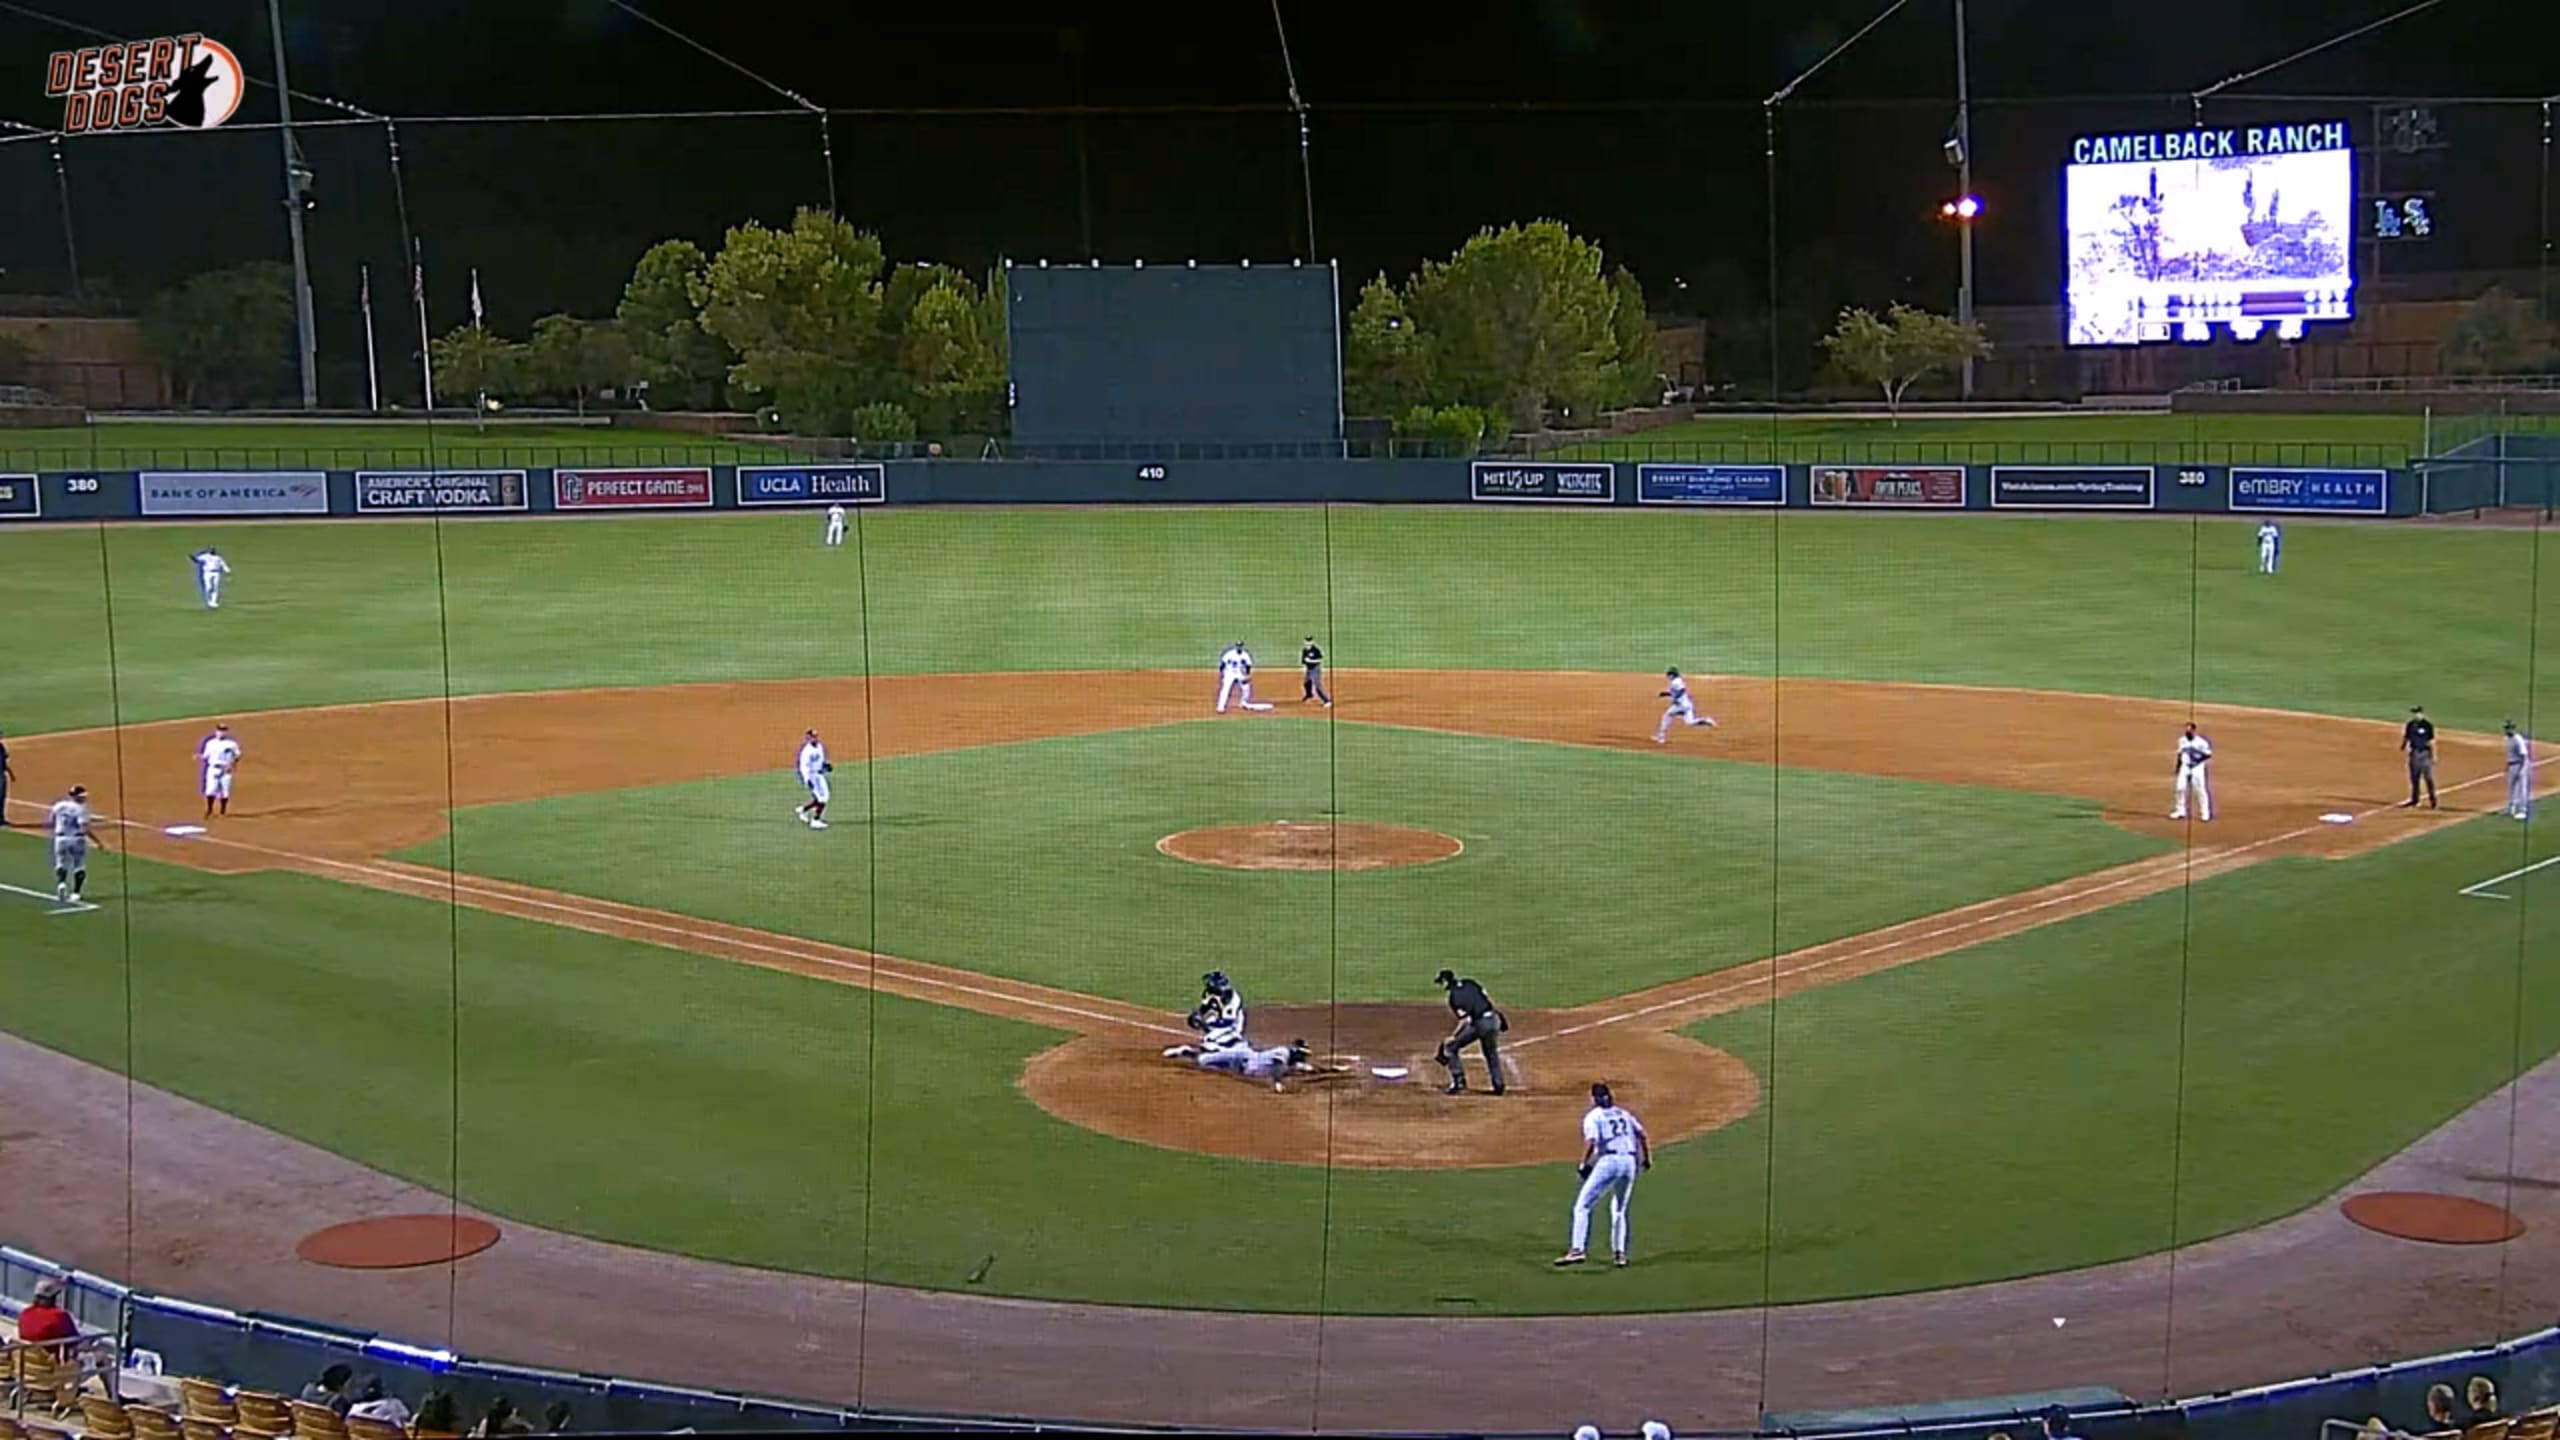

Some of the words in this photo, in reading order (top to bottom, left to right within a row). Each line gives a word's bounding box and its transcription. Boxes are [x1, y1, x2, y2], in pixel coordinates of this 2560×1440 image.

[2074, 130, 2234, 164] CAMELBACK
[2247, 123, 2344, 152] RANCH
[1139, 467, 1165, 479] 410
[2179, 471, 2205, 485] 380
[67, 479, 98, 492] 380
[435, 476, 490, 488] ORIGINAL
[587, 480, 645, 496] PERFECT
[759, 477, 800, 492] UCLA
[811, 475, 870, 493] Health
[2311, 482, 2375, 495] HEALTH
[151, 489, 192, 498] BANK
[196, 489, 215, 498] OF
[219, 488, 287, 498] AMERICA
[368, 489, 426, 505] CRAFT
[430, 488, 491, 504] VODKA
